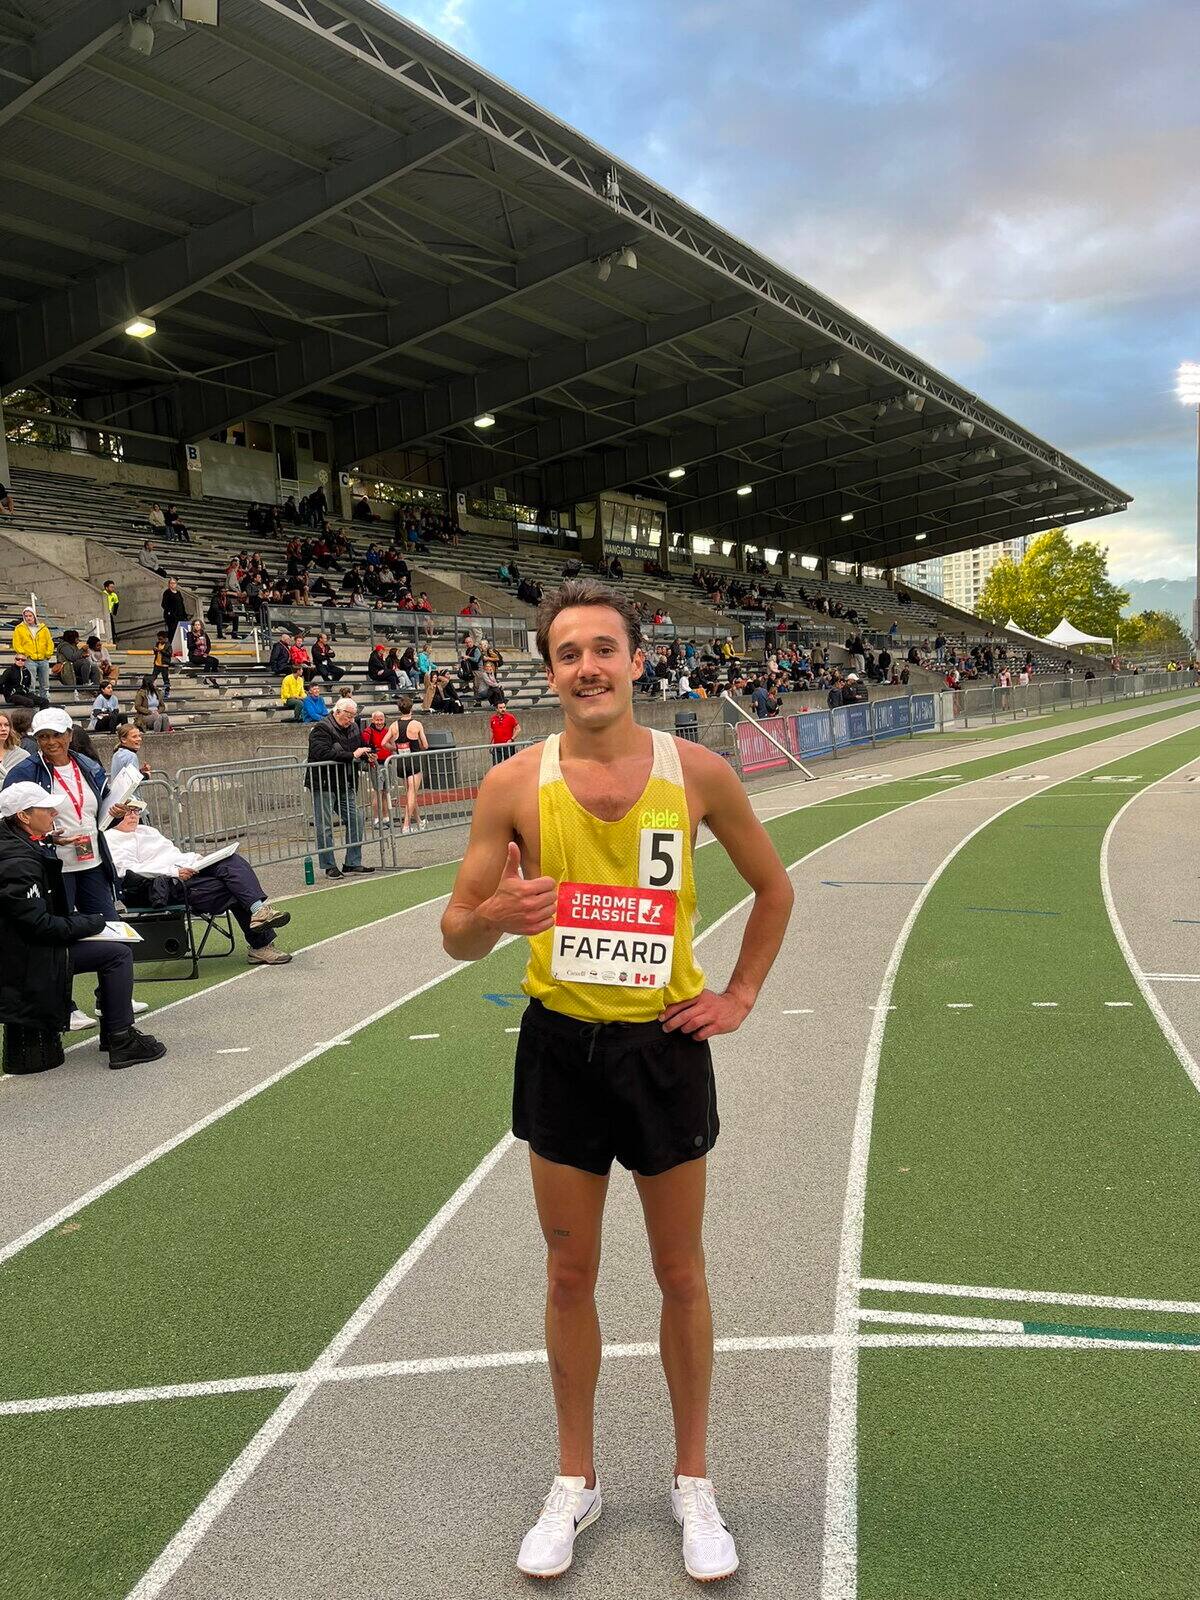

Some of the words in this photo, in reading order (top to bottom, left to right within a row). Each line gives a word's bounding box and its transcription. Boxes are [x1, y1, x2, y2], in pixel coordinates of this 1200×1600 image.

[189, 447, 197, 459] B
[634, 547, 658, 560] STADIUM
[641, 808, 679, 828] ciele
[649, 833, 674, 887] 5
[571, 893, 637, 910] JEROME
[571, 906, 636, 923] CLASSIC
[560, 935, 667, 965] FAFARD
